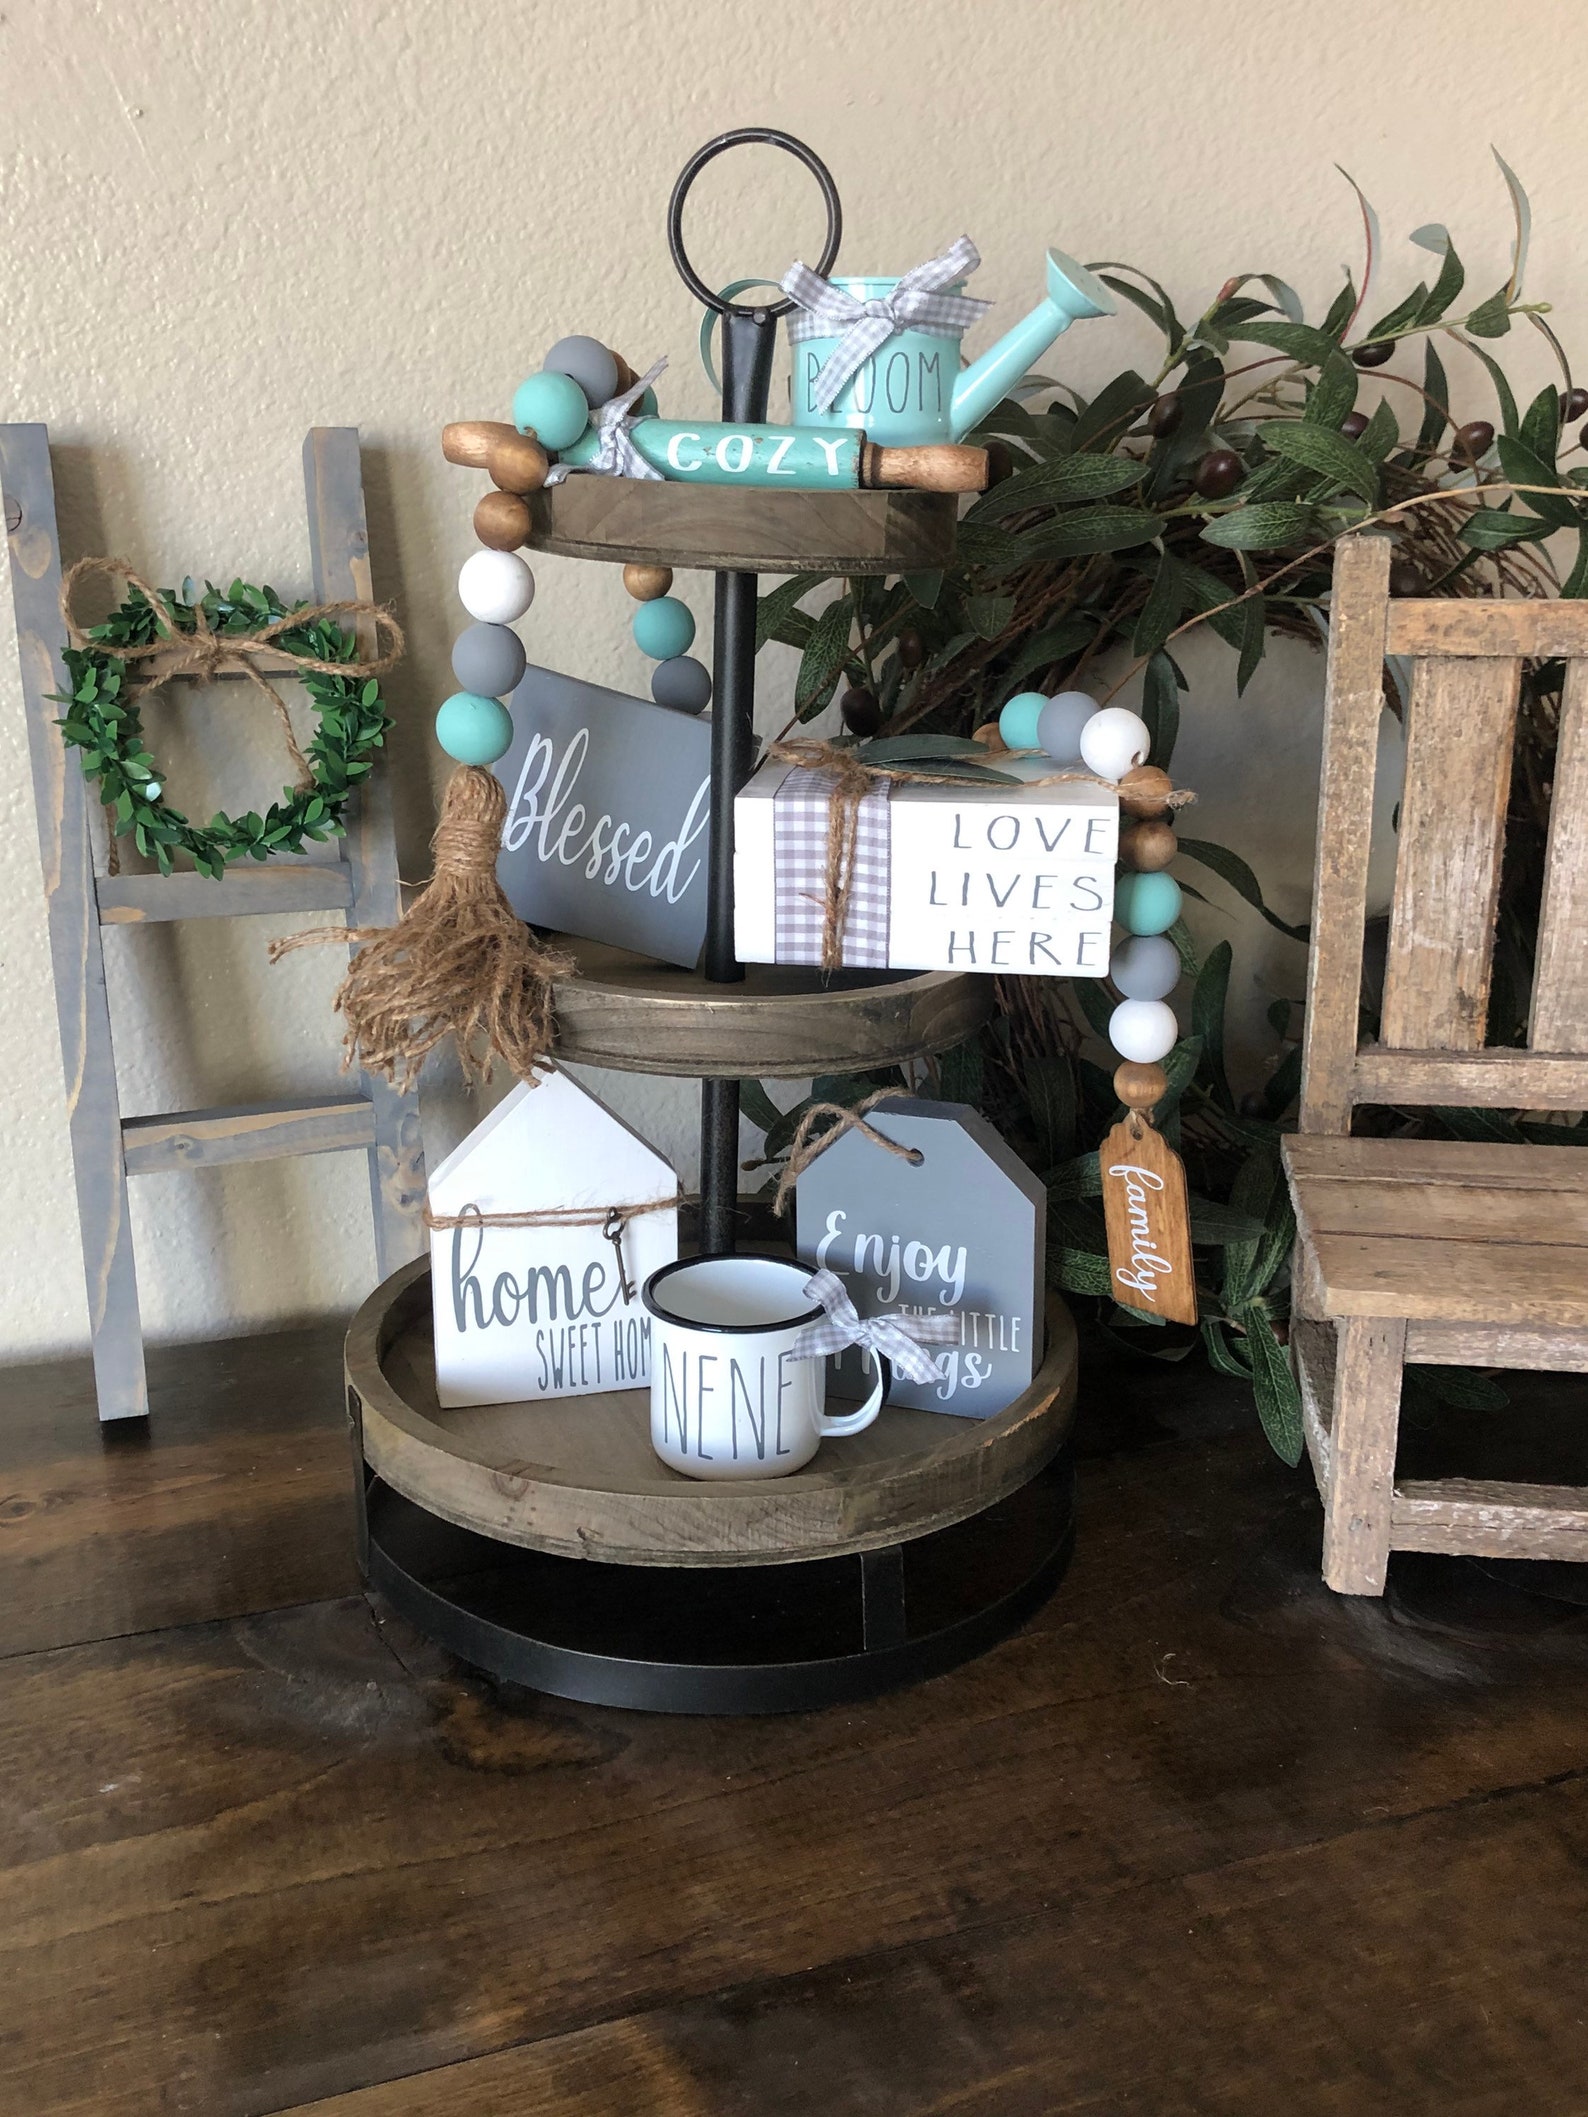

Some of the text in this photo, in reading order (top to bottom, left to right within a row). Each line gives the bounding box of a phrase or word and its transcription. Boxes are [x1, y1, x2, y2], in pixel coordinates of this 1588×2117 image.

[667, 432, 848, 476] COZY
[501, 728, 711, 904] Blessed
[953, 813, 1111, 854] LOVE
[929, 871, 1103, 911] LIVES
[947, 930, 1102, 966] HERE
[452, 1203, 622, 1332] home
[816, 1210, 967, 1306] Enjoy
[1108, 1165, 1173, 1302] family
[536, 1316, 651, 1391] SWEET HOM
[949, 1310, 1022, 1353] ITTLE
[663, 1342, 793, 1460] NENE
